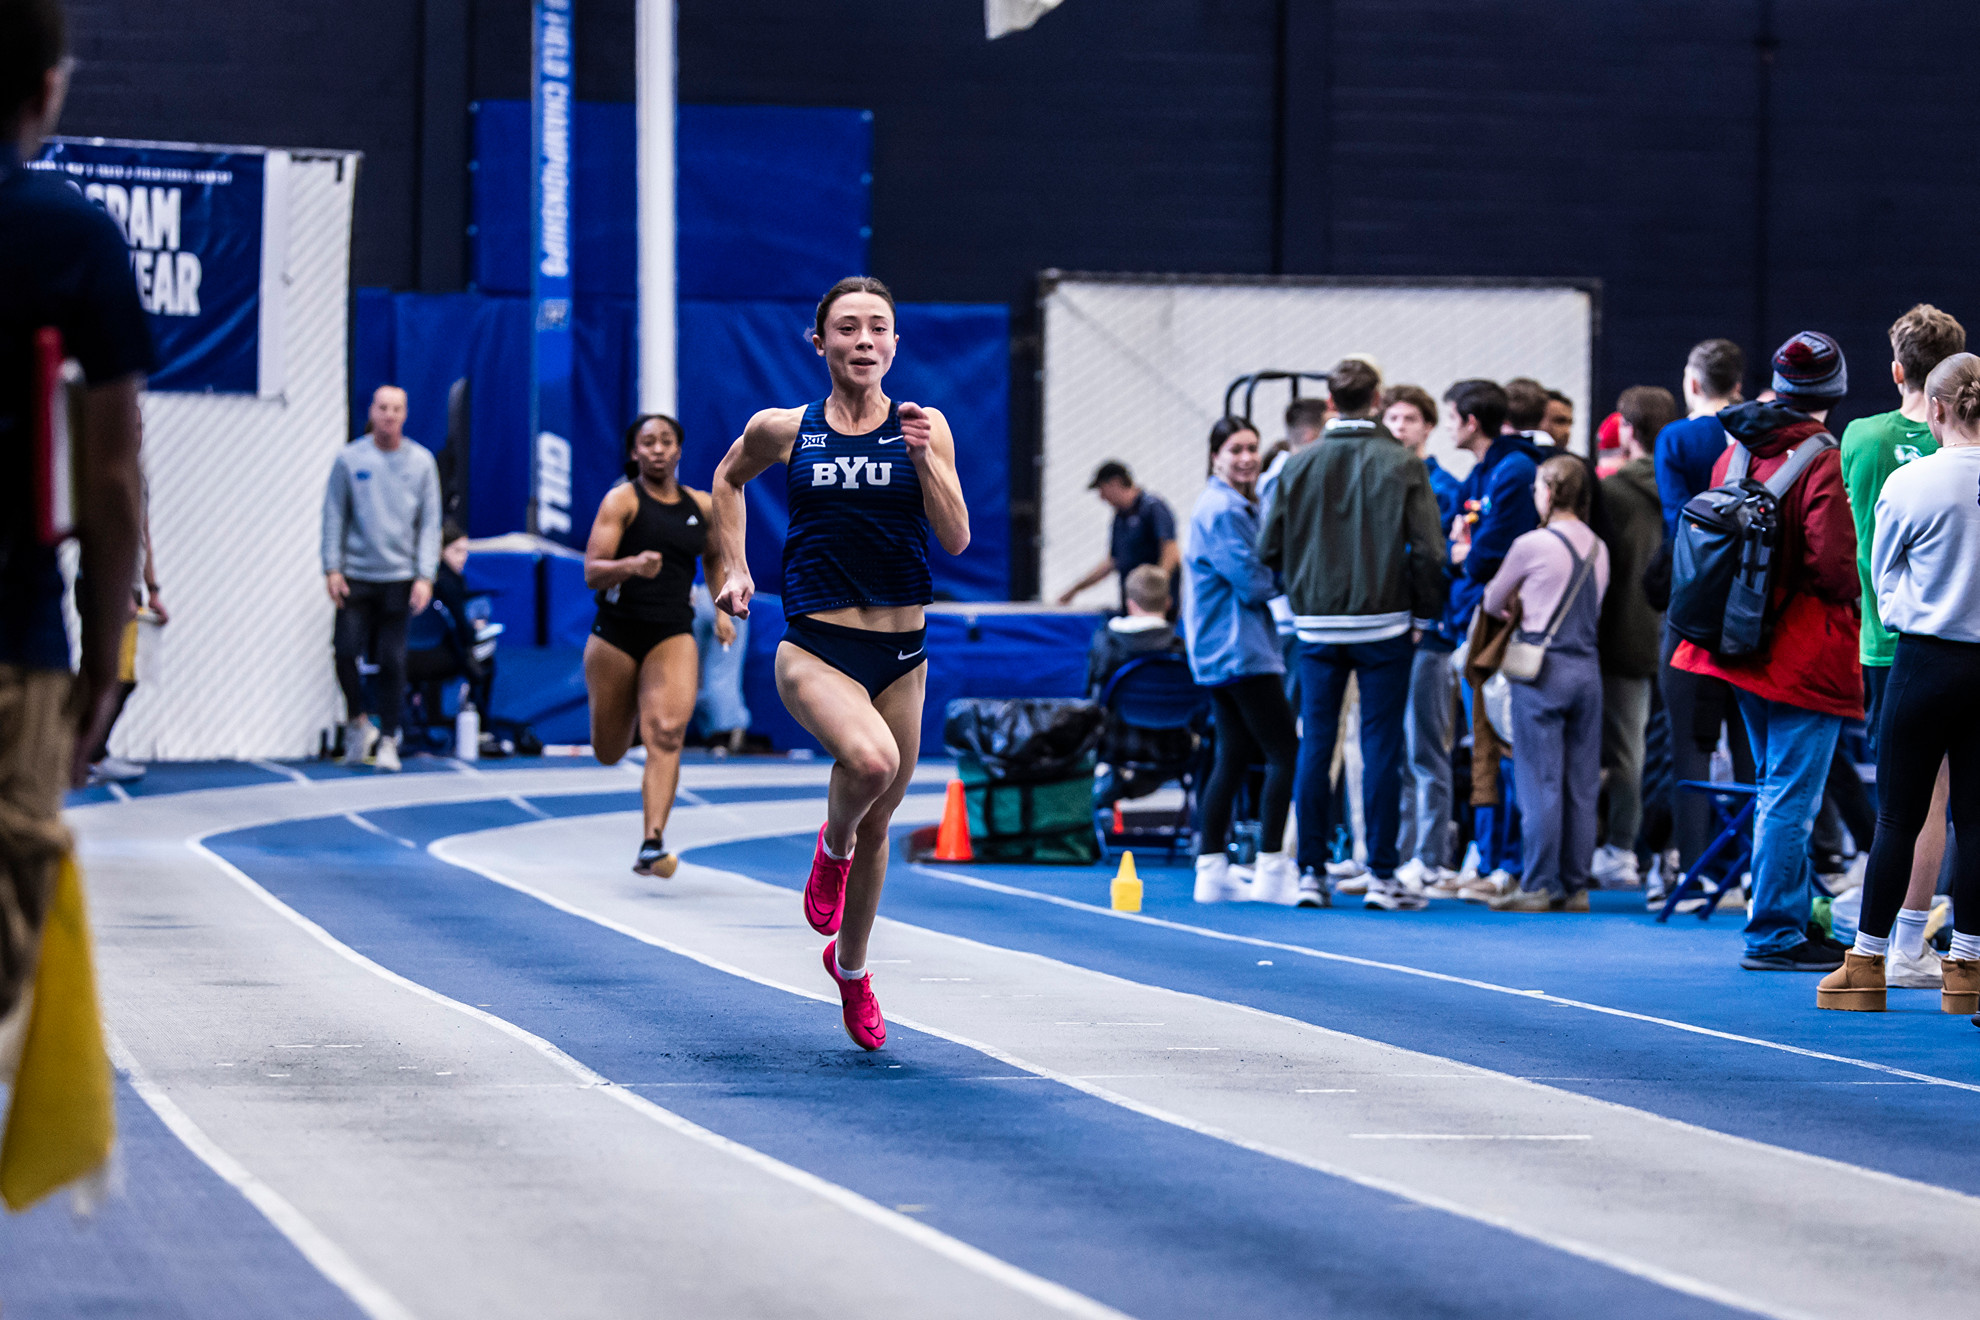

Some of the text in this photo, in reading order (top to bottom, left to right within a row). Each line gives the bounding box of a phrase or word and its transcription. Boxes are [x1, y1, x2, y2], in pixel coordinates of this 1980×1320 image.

[66, 180, 182, 250] RAM
[128, 250, 203, 316] EAR
[812, 457, 892, 489] BYU
